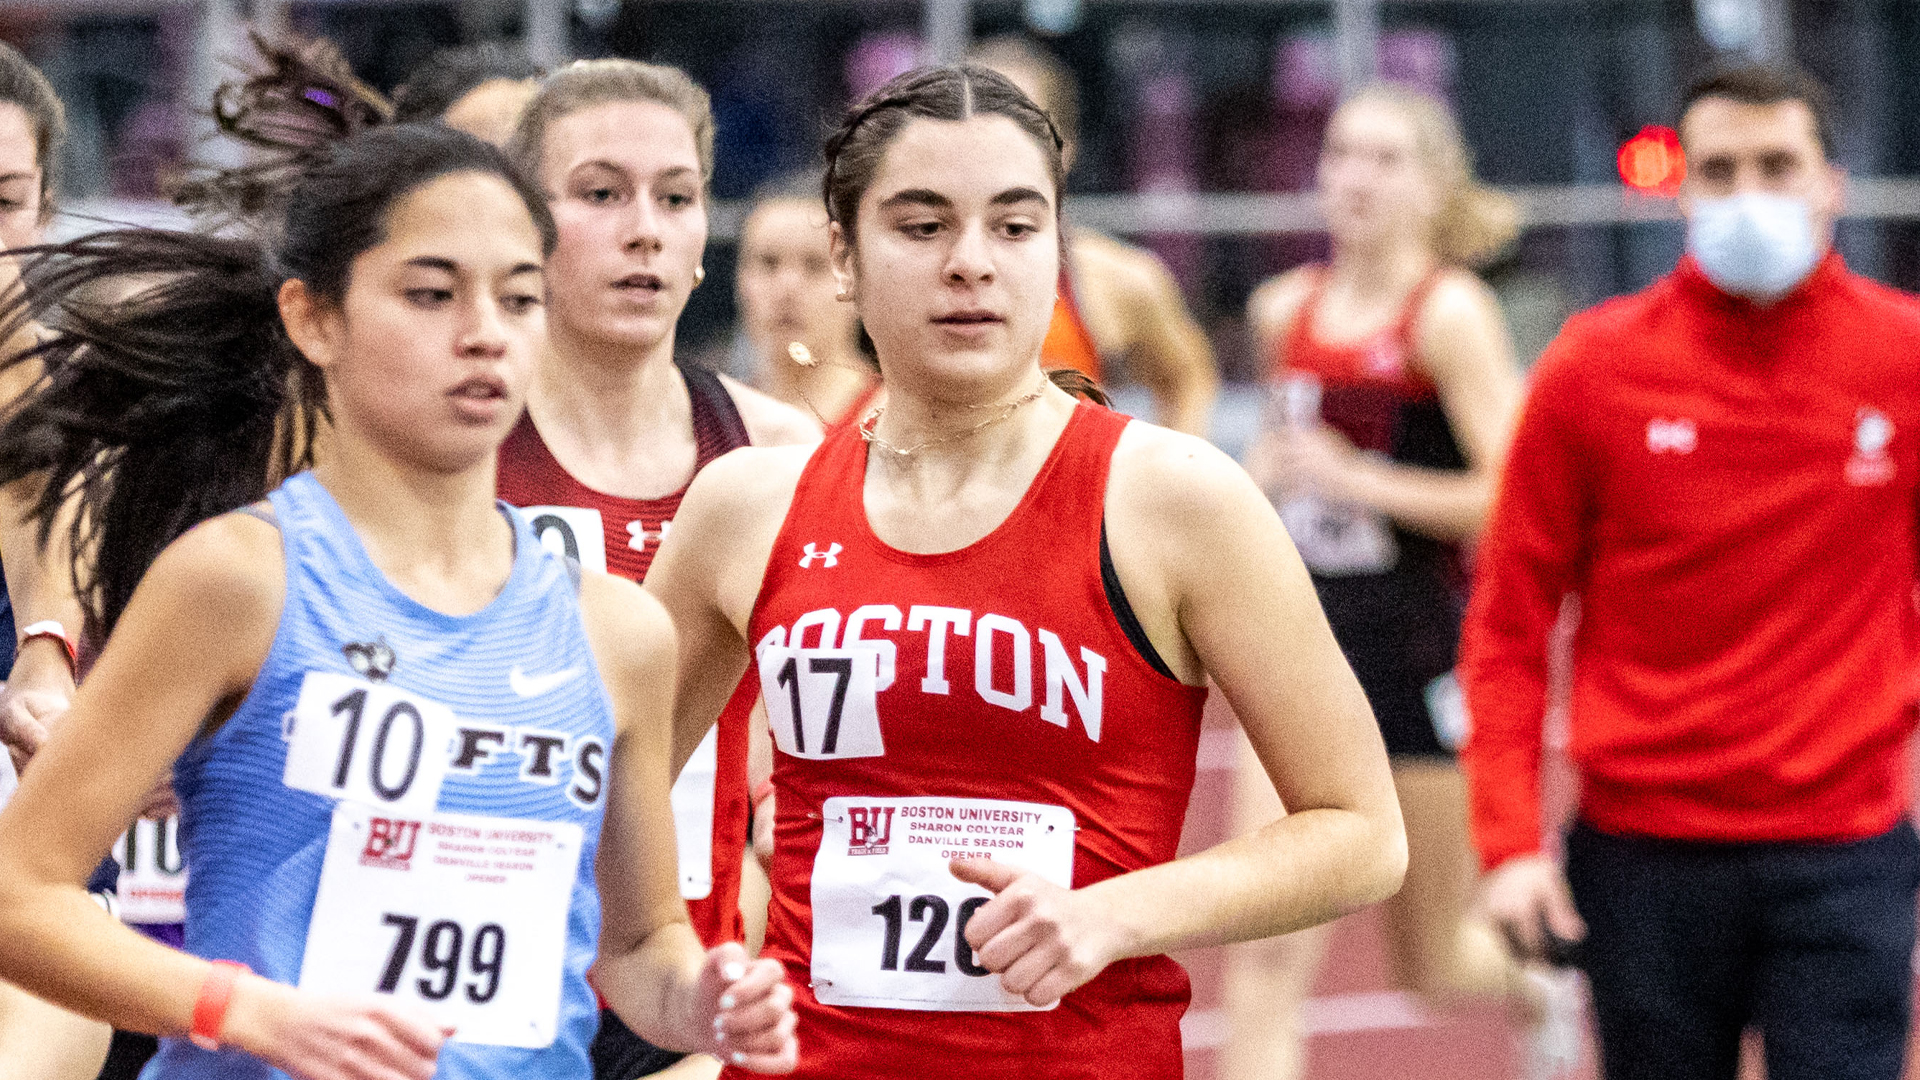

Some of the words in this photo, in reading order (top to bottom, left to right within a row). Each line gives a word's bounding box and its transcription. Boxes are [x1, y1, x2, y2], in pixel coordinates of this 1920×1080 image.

[777, 657, 852, 754] 17
[331, 689, 424, 802] 10
[452, 727, 605, 804] FTS
[901, 806, 954, 819] BOSTON
[959, 808, 1042, 824] UNIVERSITY
[908, 835, 969, 847] DANVILLE
[974, 838, 1024, 849] SEASON
[910, 822, 962, 833] SHARON
[967, 825, 1024, 836] COLYEAR
[377, 912, 506, 1004] 799
